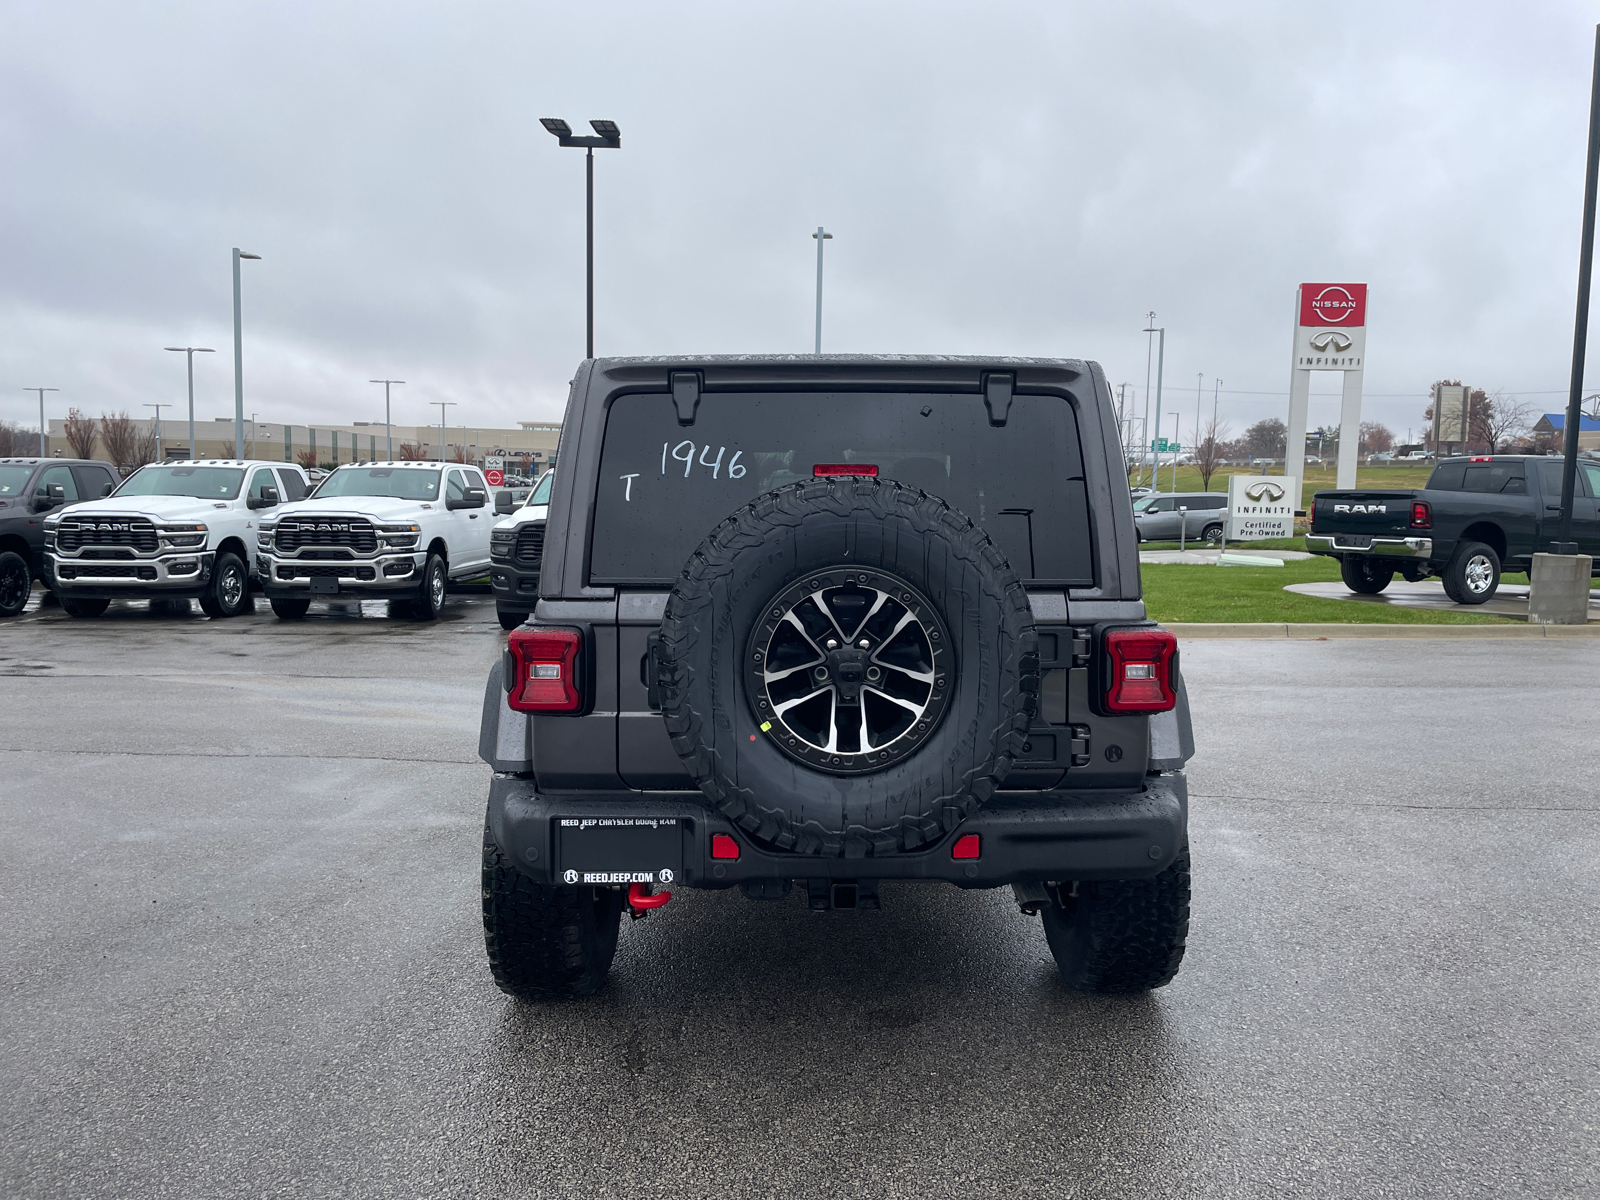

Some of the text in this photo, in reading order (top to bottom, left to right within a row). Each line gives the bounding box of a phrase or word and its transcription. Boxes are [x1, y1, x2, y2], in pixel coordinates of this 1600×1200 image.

[1300, 357, 1360, 366] INFINITI
[661, 440, 747, 479] 1946
[619, 473, 640, 501] T
[1237, 506, 1290, 514] INFINITI
[1334, 505, 1387, 514] RAM
[80, 523, 129, 531] RAM
[300, 523, 348, 531] RAM
[1245, 521, 1282, 529] Certified
[1240, 529, 1286, 537] Pre-Owned
[560, 819, 579, 827] REED
[580, 819, 598, 827] JEEP
[598, 818, 634, 826] CHRYSLER
[583, 872, 654, 883] REEDJEEP.COM
